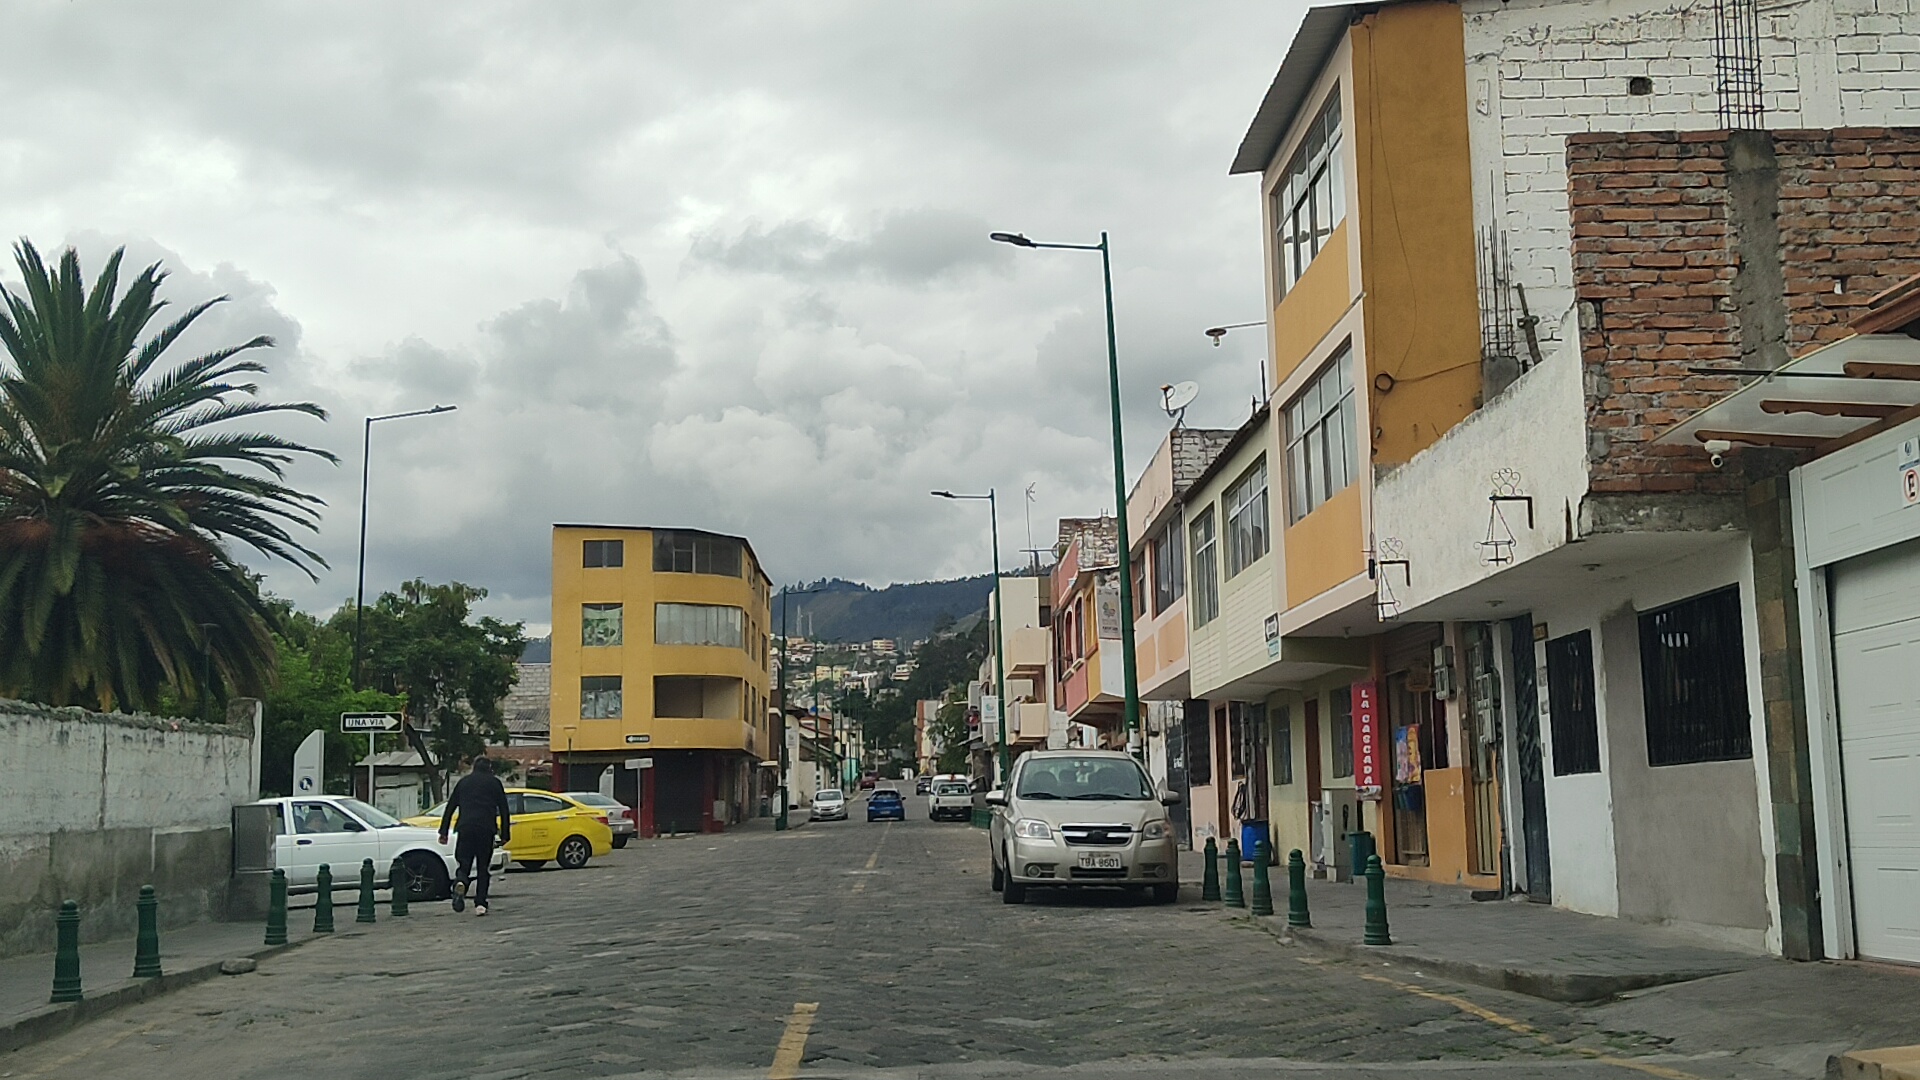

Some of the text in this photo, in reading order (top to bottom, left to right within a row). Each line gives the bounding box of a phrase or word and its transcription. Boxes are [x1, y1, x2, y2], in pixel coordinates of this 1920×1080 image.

[348, 718, 367, 727] UNA
[1360, 689, 1373, 785] LA CASCADA
